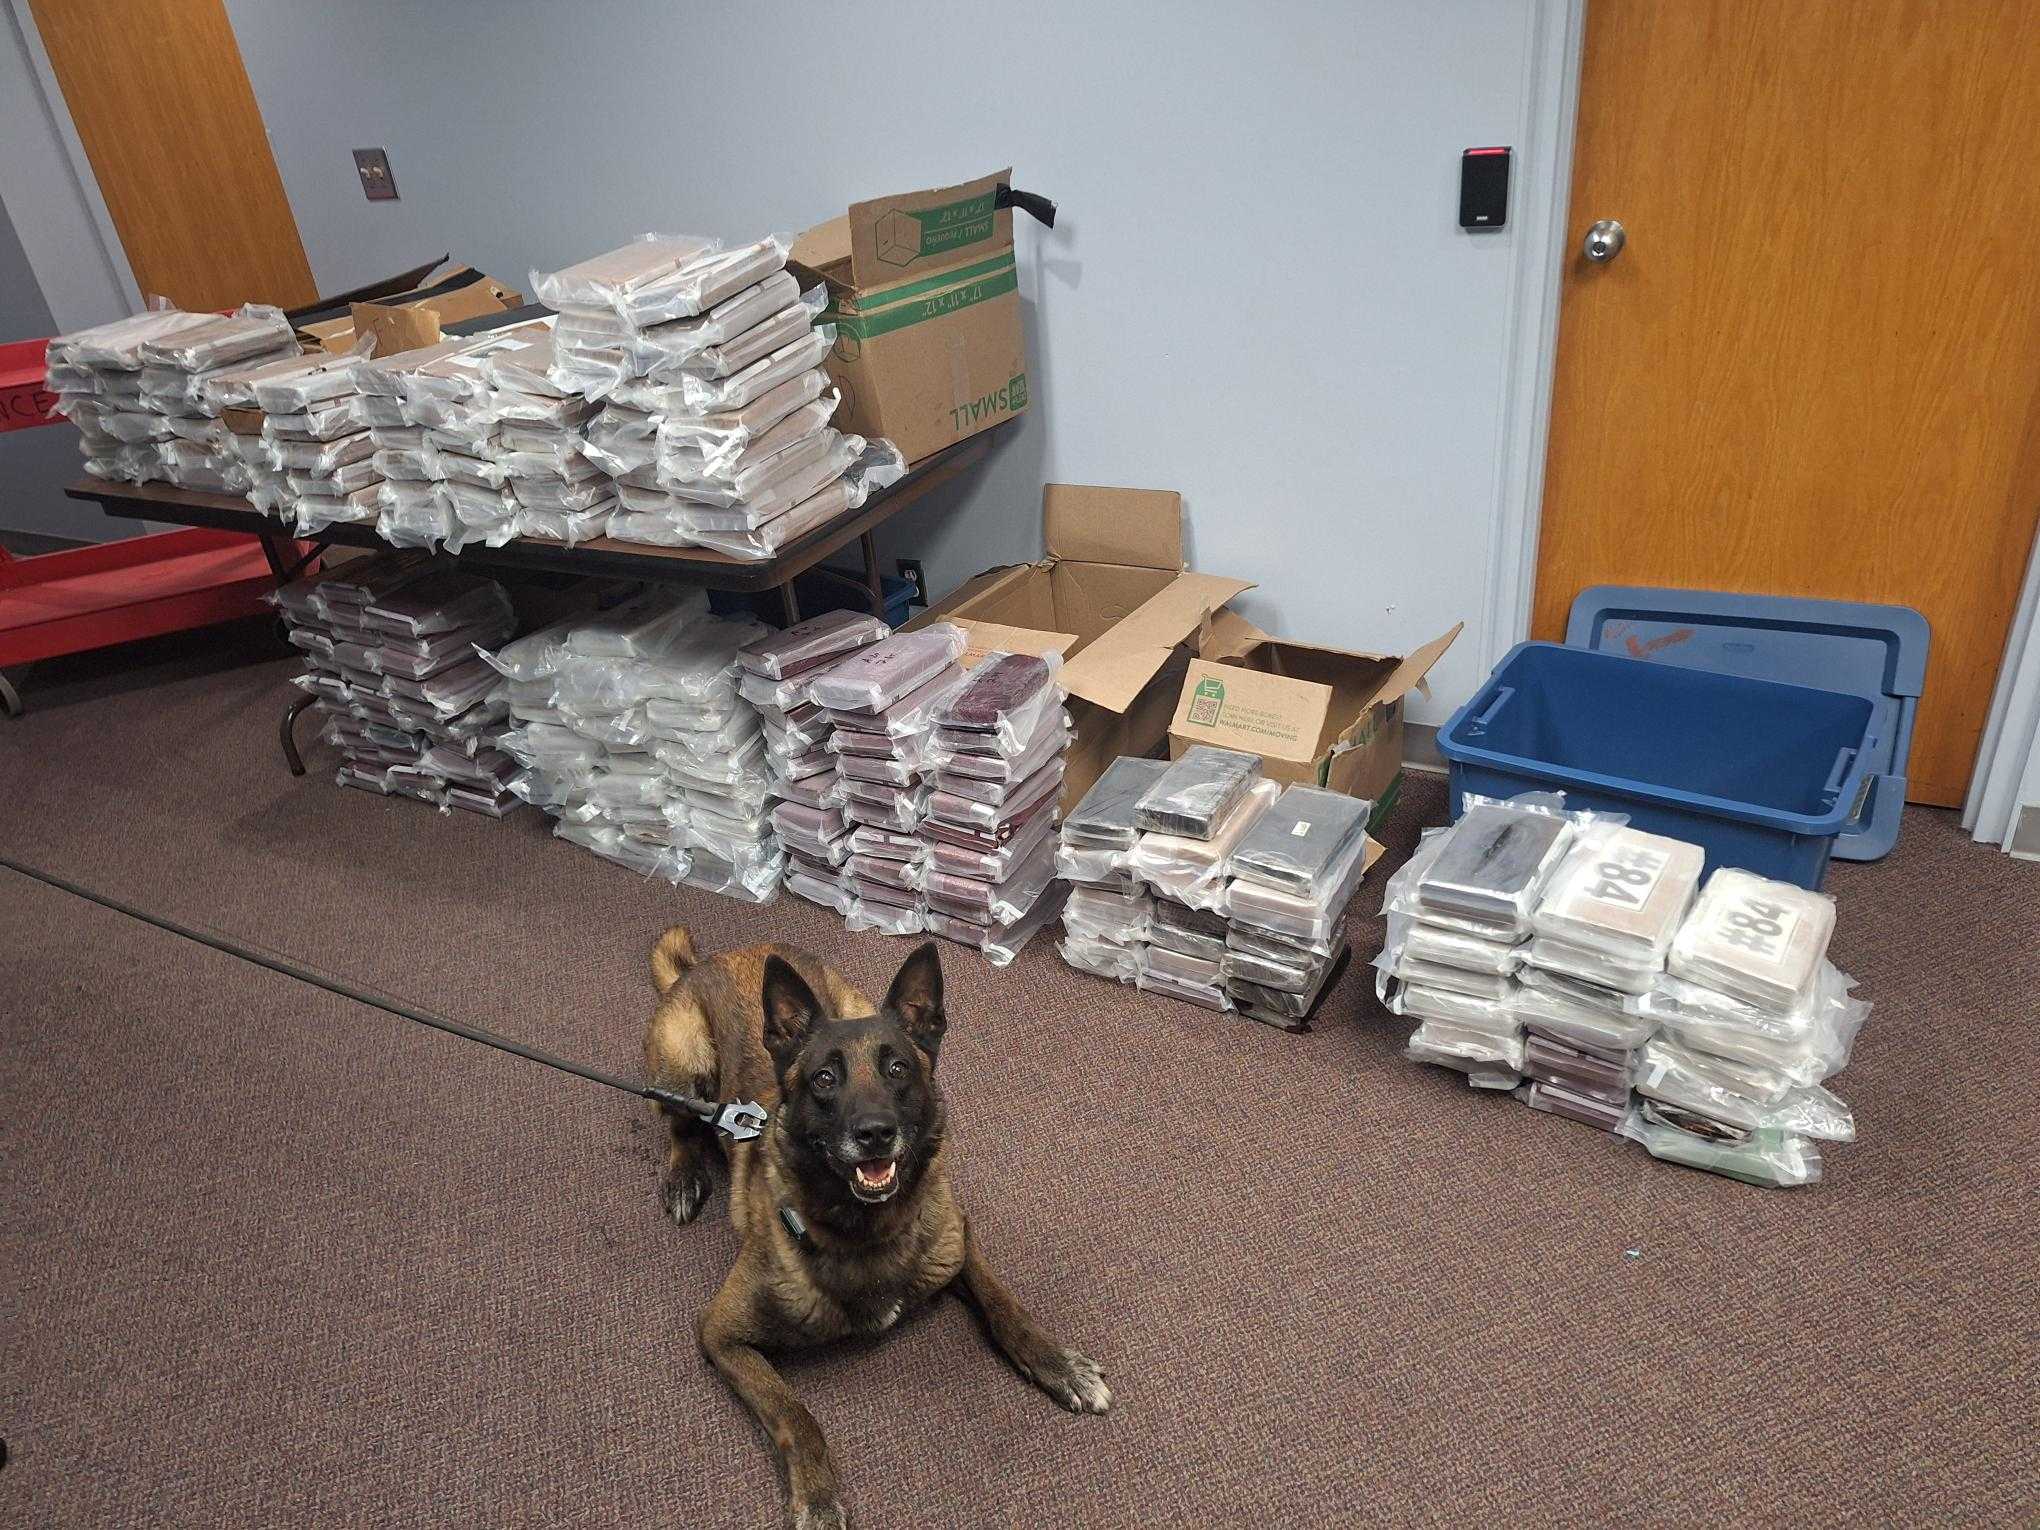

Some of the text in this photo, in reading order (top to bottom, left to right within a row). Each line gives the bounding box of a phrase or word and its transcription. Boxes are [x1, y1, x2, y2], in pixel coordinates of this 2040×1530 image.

[949, 388, 1008, 431] SMALL
[1219, 719, 1298, 742] WALMART.COM/MOVING
[1584, 845, 1662, 905] #84
[1716, 896, 1790, 956] #84
